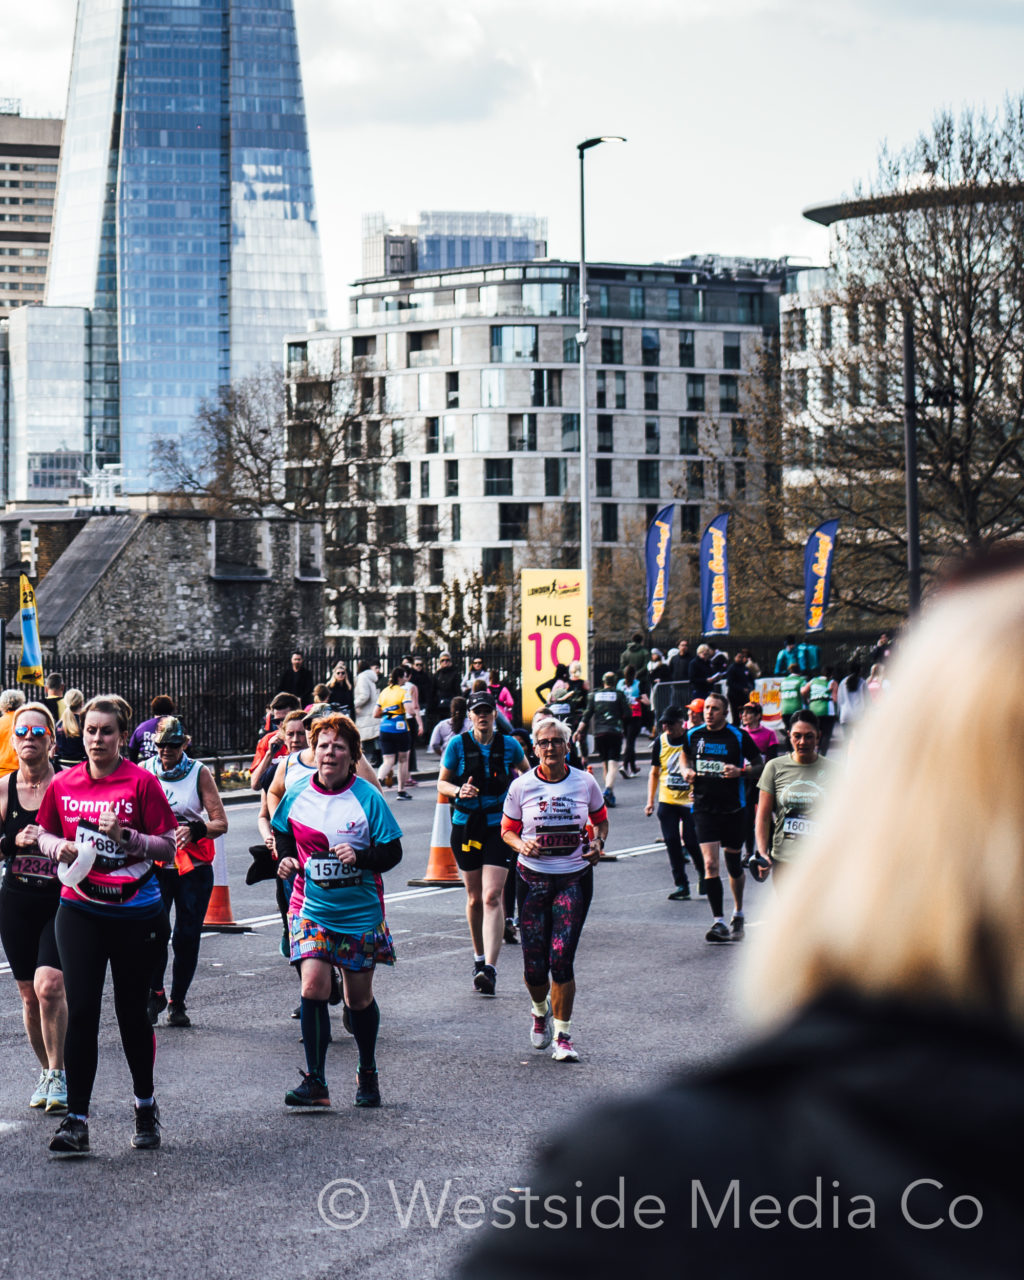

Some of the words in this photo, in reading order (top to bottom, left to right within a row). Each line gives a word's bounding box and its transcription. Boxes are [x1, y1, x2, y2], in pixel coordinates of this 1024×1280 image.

[712, 575, 726, 604] Kids
[536, 615, 571, 626] MILE
[712, 605, 726, 629] Get
[808, 606, 823, 628] Get
[528, 632, 581, 672] 10
